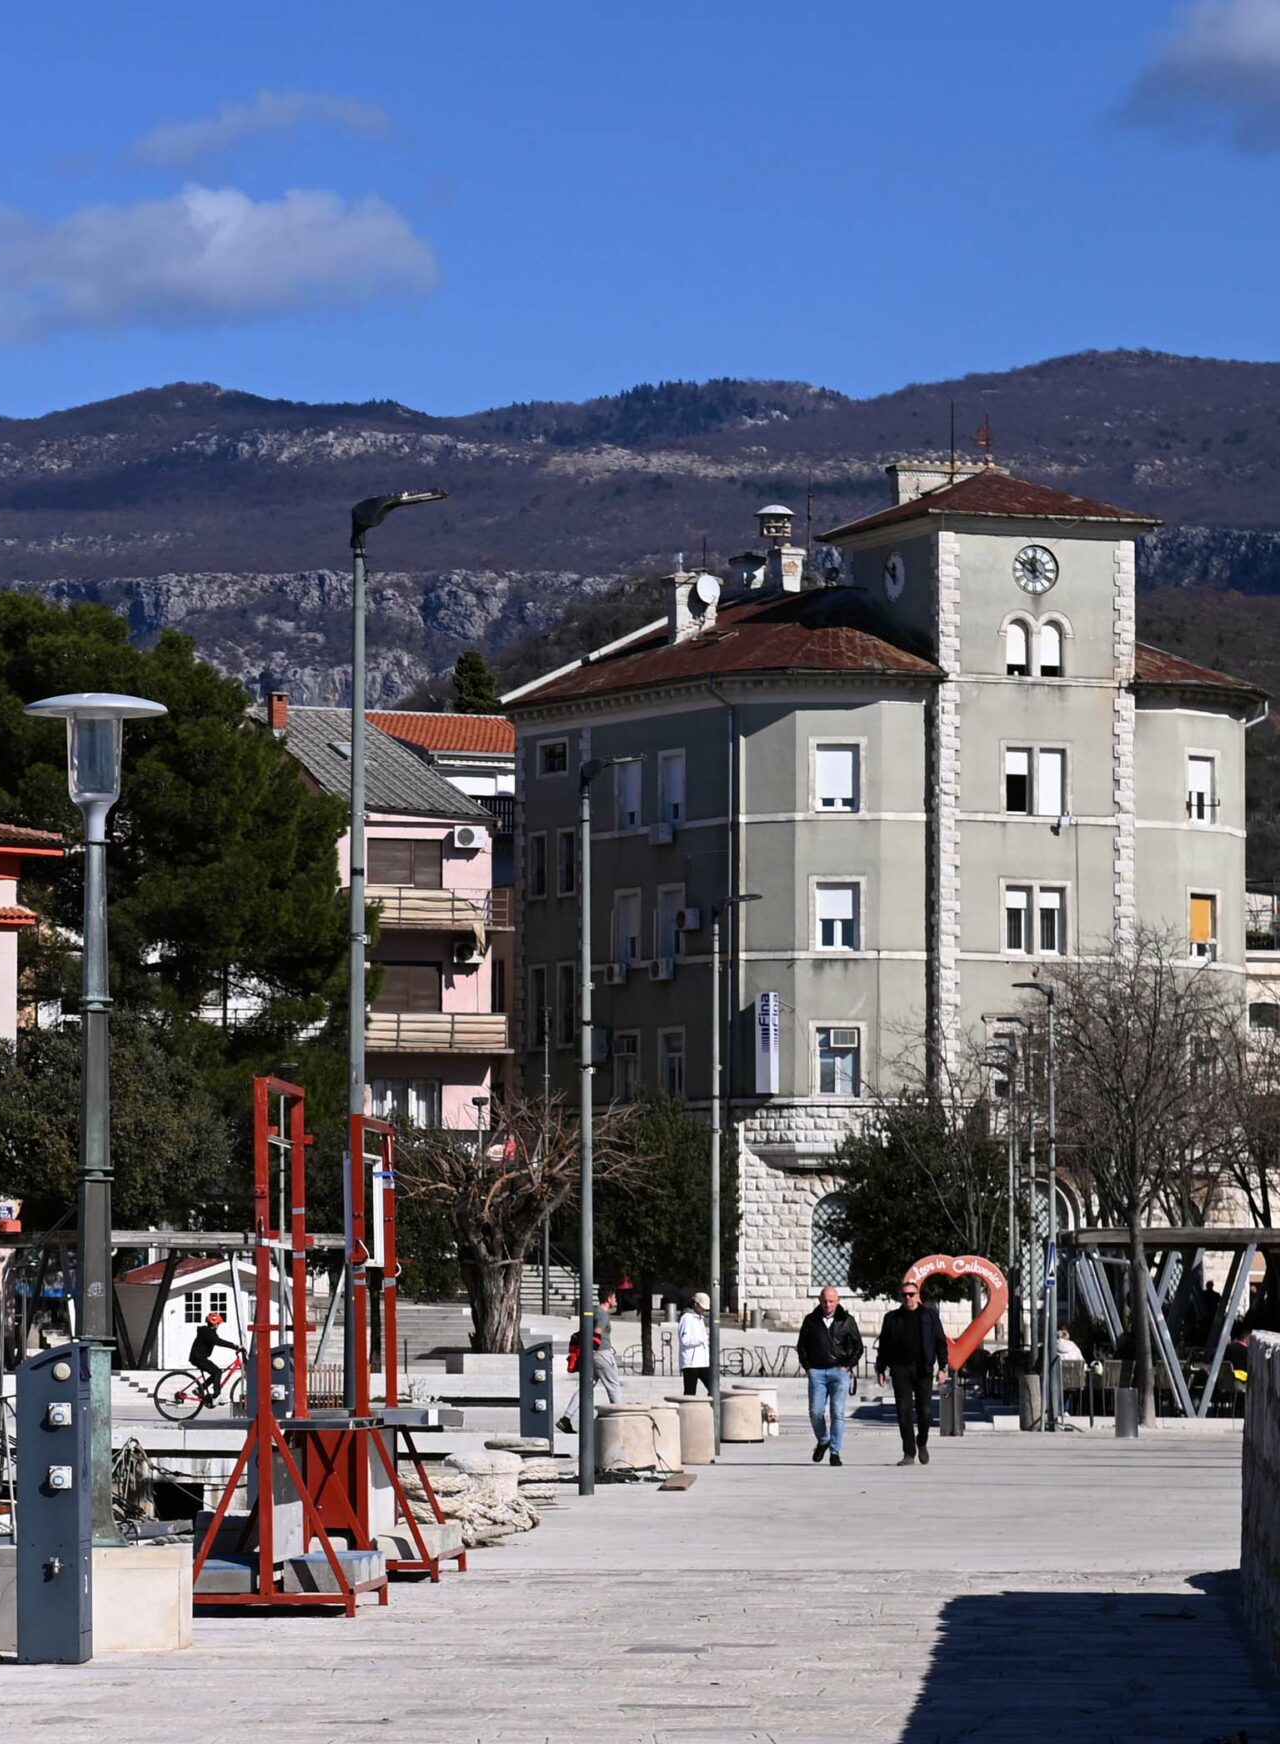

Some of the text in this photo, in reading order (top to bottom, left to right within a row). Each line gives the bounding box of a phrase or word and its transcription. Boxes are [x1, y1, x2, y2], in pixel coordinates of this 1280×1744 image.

[759, 993, 770, 1027] Fina
[936, 1259, 946, 1269] in
[953, 1260, 1003, 1290] Crikvenica
